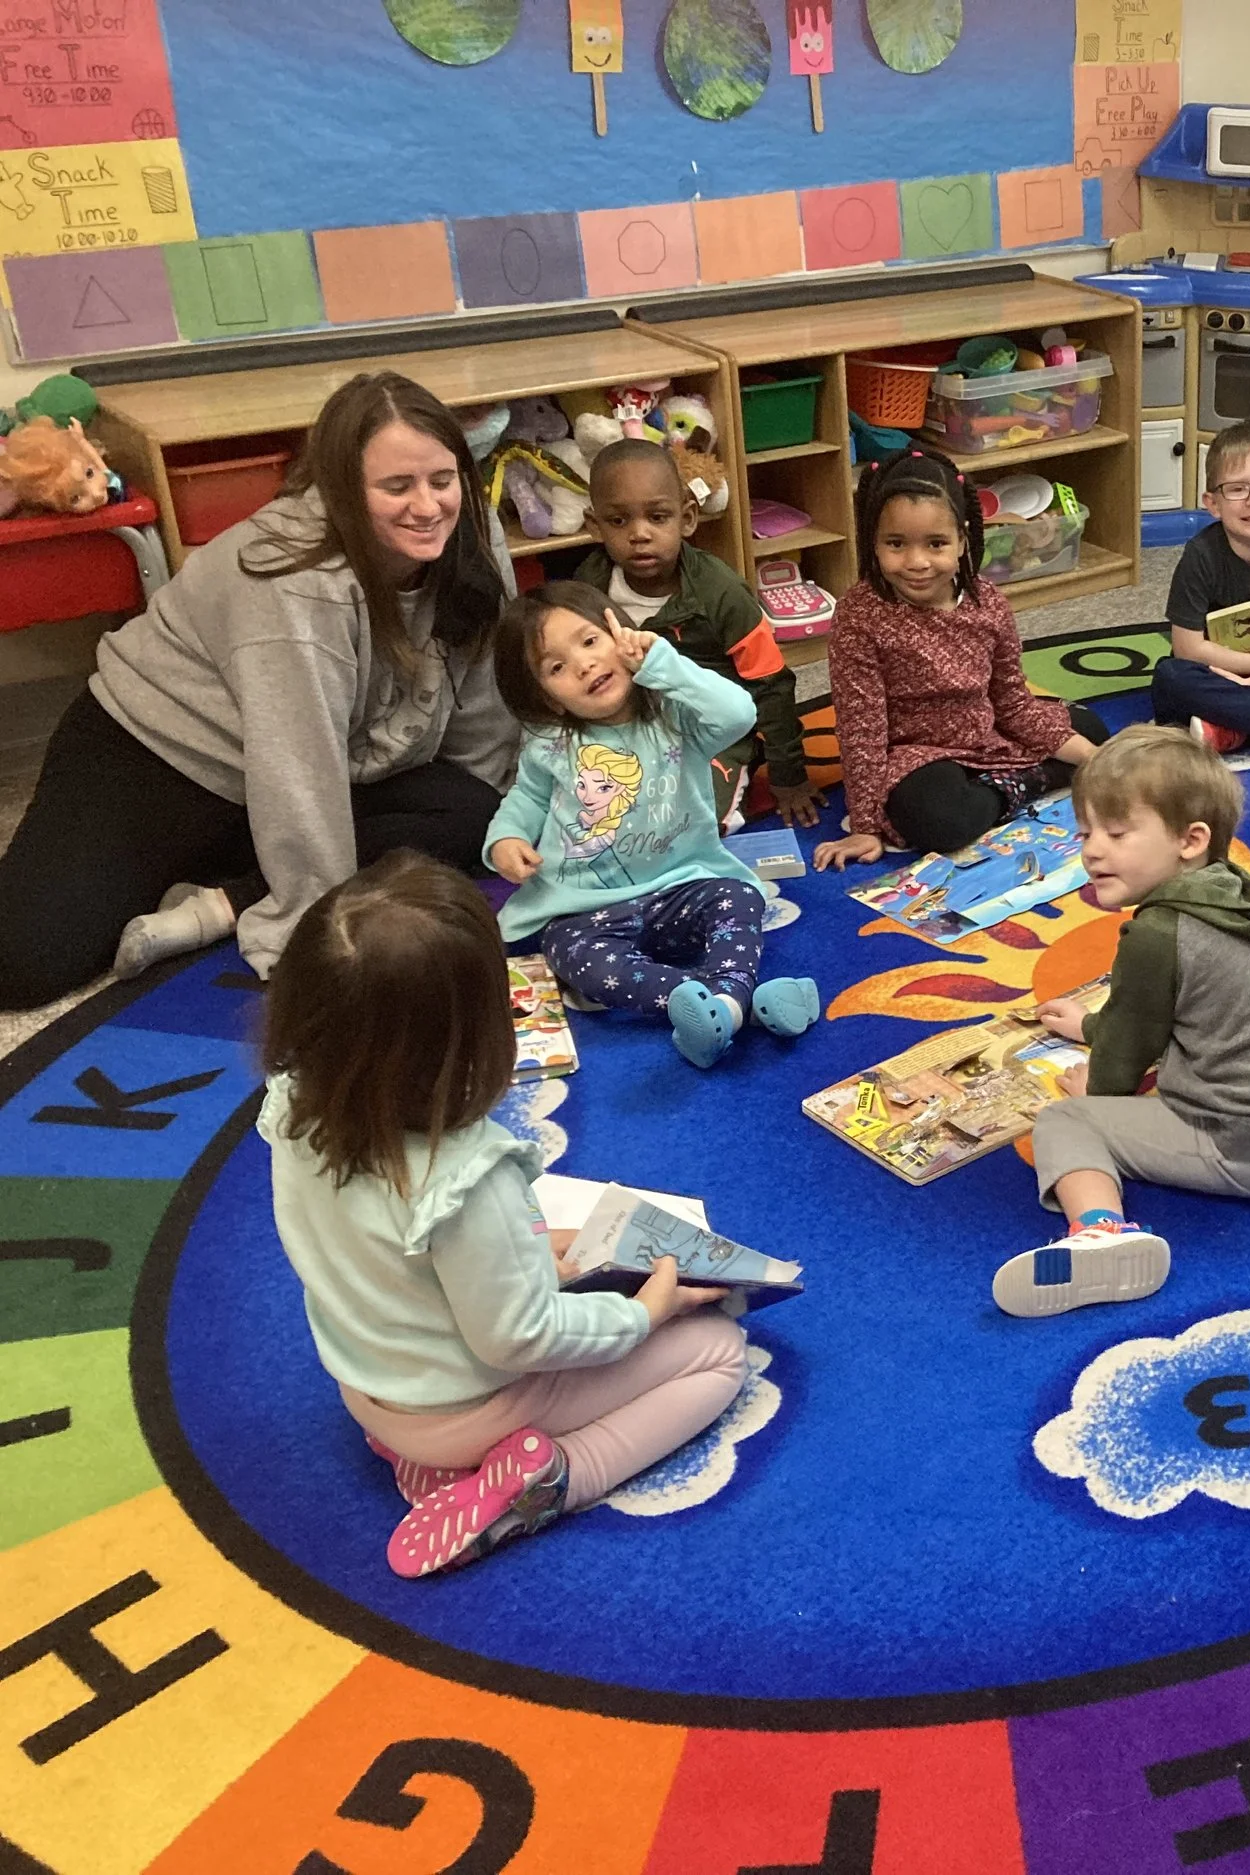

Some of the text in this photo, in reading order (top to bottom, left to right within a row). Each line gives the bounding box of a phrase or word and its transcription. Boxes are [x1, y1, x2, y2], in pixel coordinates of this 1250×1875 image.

[0, 17, 47, 38] arge
[1113, 16, 1143, 43] Time
[0, 43, 120, 82] Free Time
[1105, 66, 1156, 94] Pick Up
[1096, 95, 1158, 126] Free Play
[27, 152, 114, 188] Snack
[50, 189, 118, 225] Time
[1059, 646, 1155, 677] Q
[29, 1066, 227, 1130] K
[857, 1087, 870, 1111] Tonka
[0, 1569, 230, 1765] H
